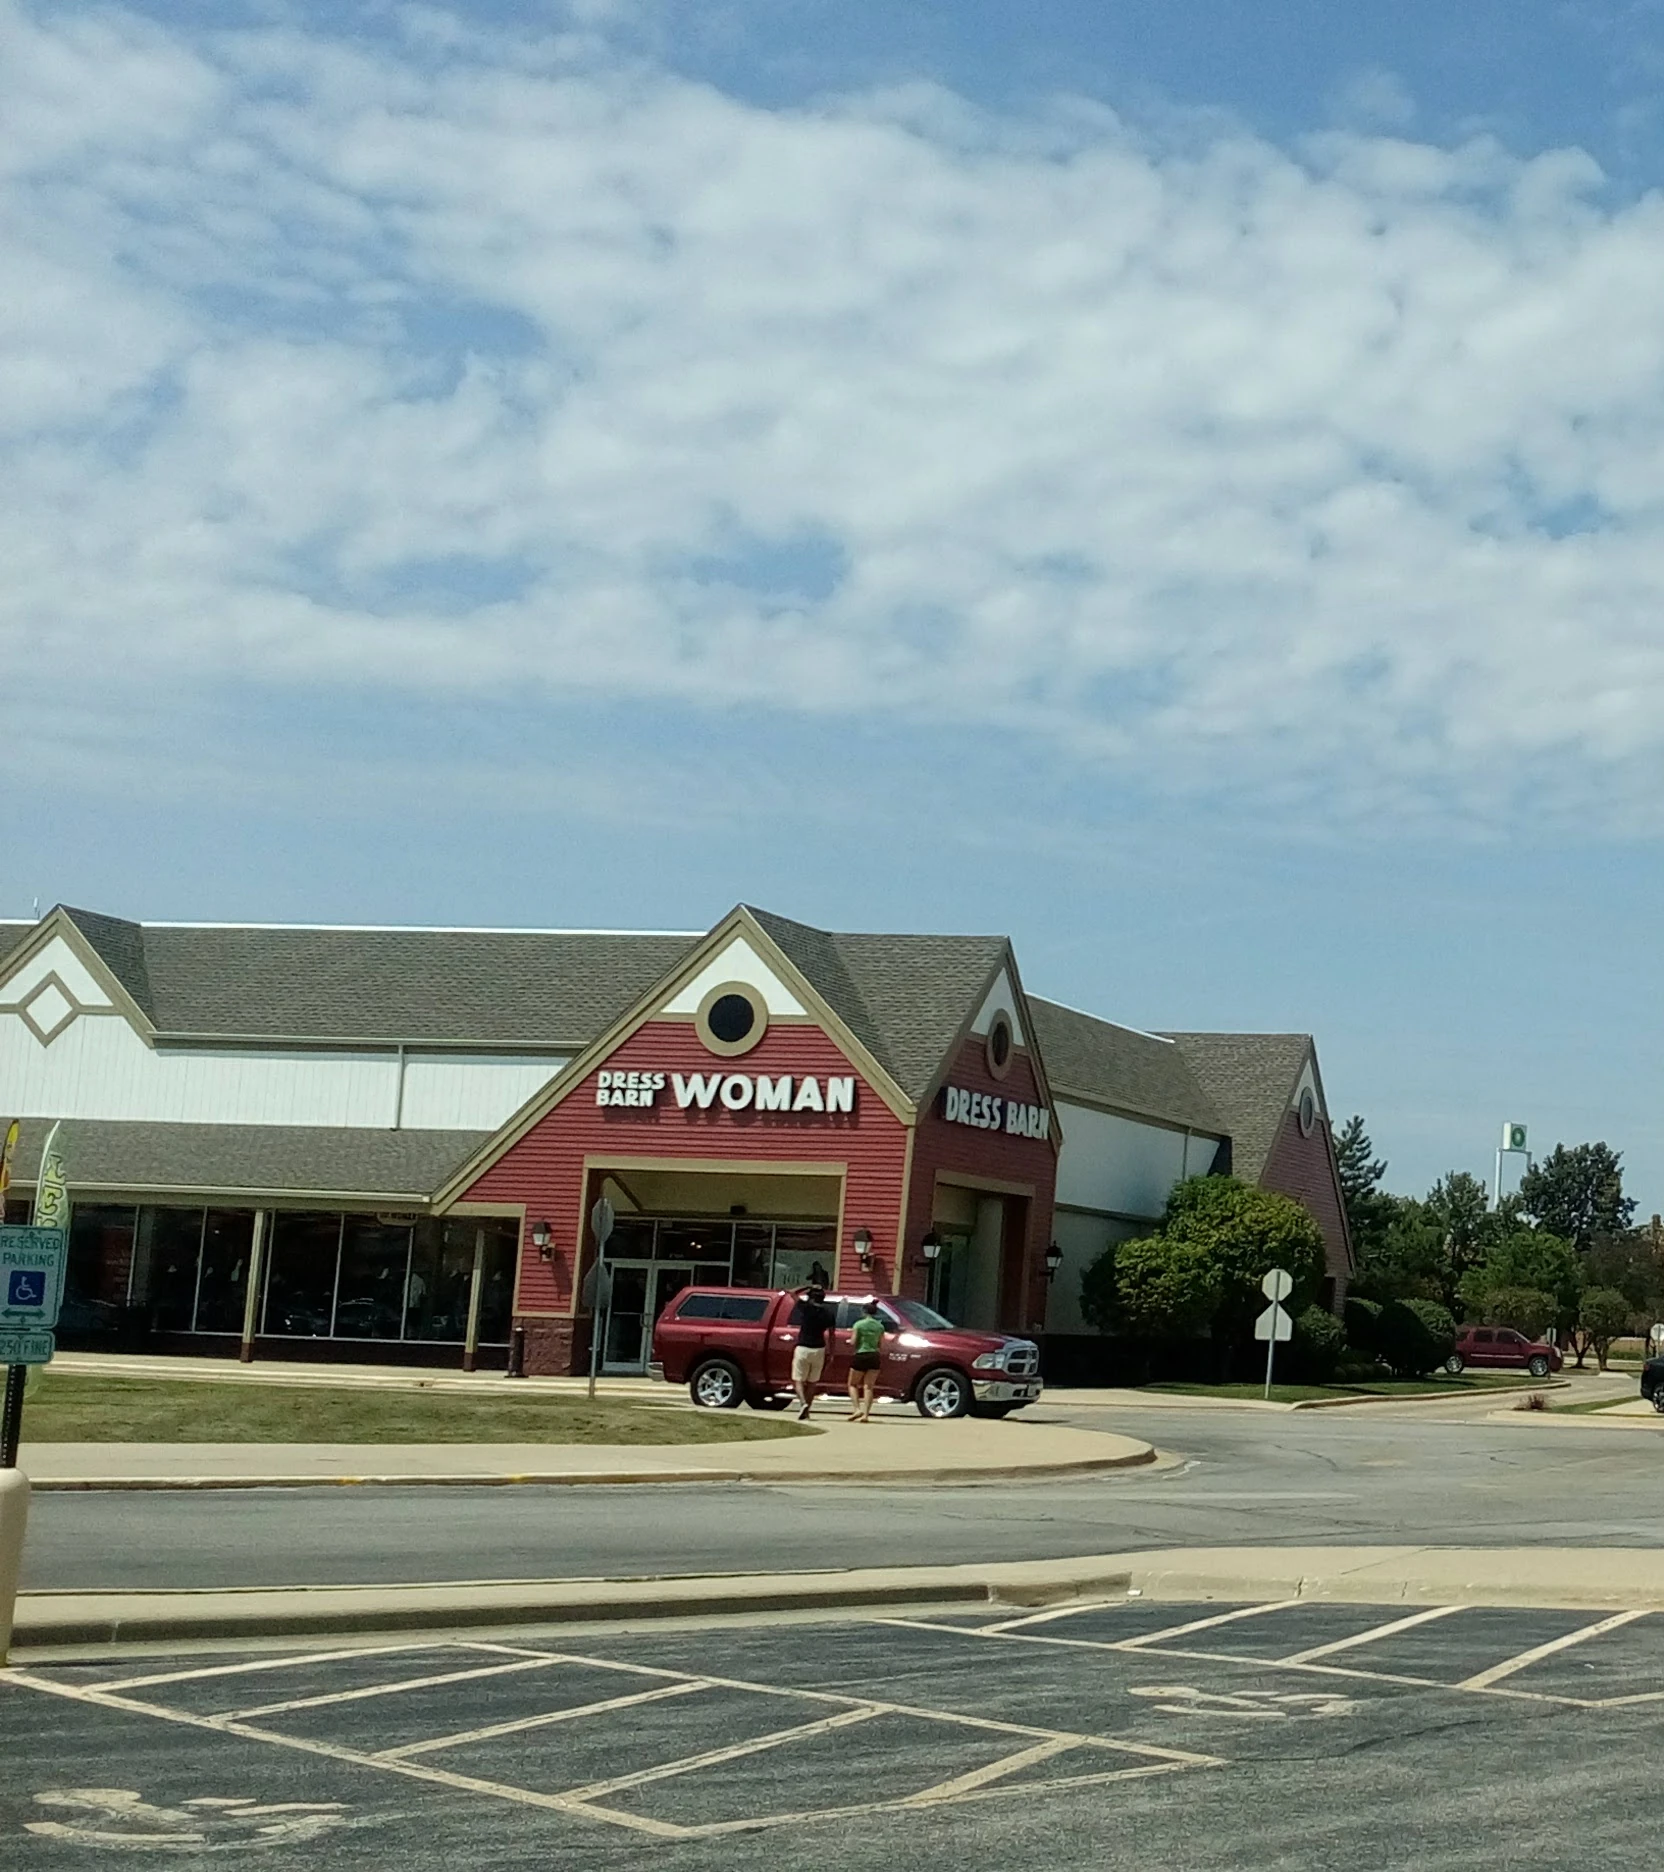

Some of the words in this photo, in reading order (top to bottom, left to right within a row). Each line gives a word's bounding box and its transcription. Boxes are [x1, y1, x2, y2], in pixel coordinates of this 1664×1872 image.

[597, 1071, 665, 1090] DRESS
[596, 1089, 654, 1107] BARN
[671, 1073, 854, 1112] WOMAN
[945, 1086, 1002, 1130] DRESS
[1005, 1101, 1050, 1140] BARN
[0, 1235, 60, 1250] RESERVED
[3, 1252, 55, 1267] PARKING
[24, 1339, 49, 1355] FINE
